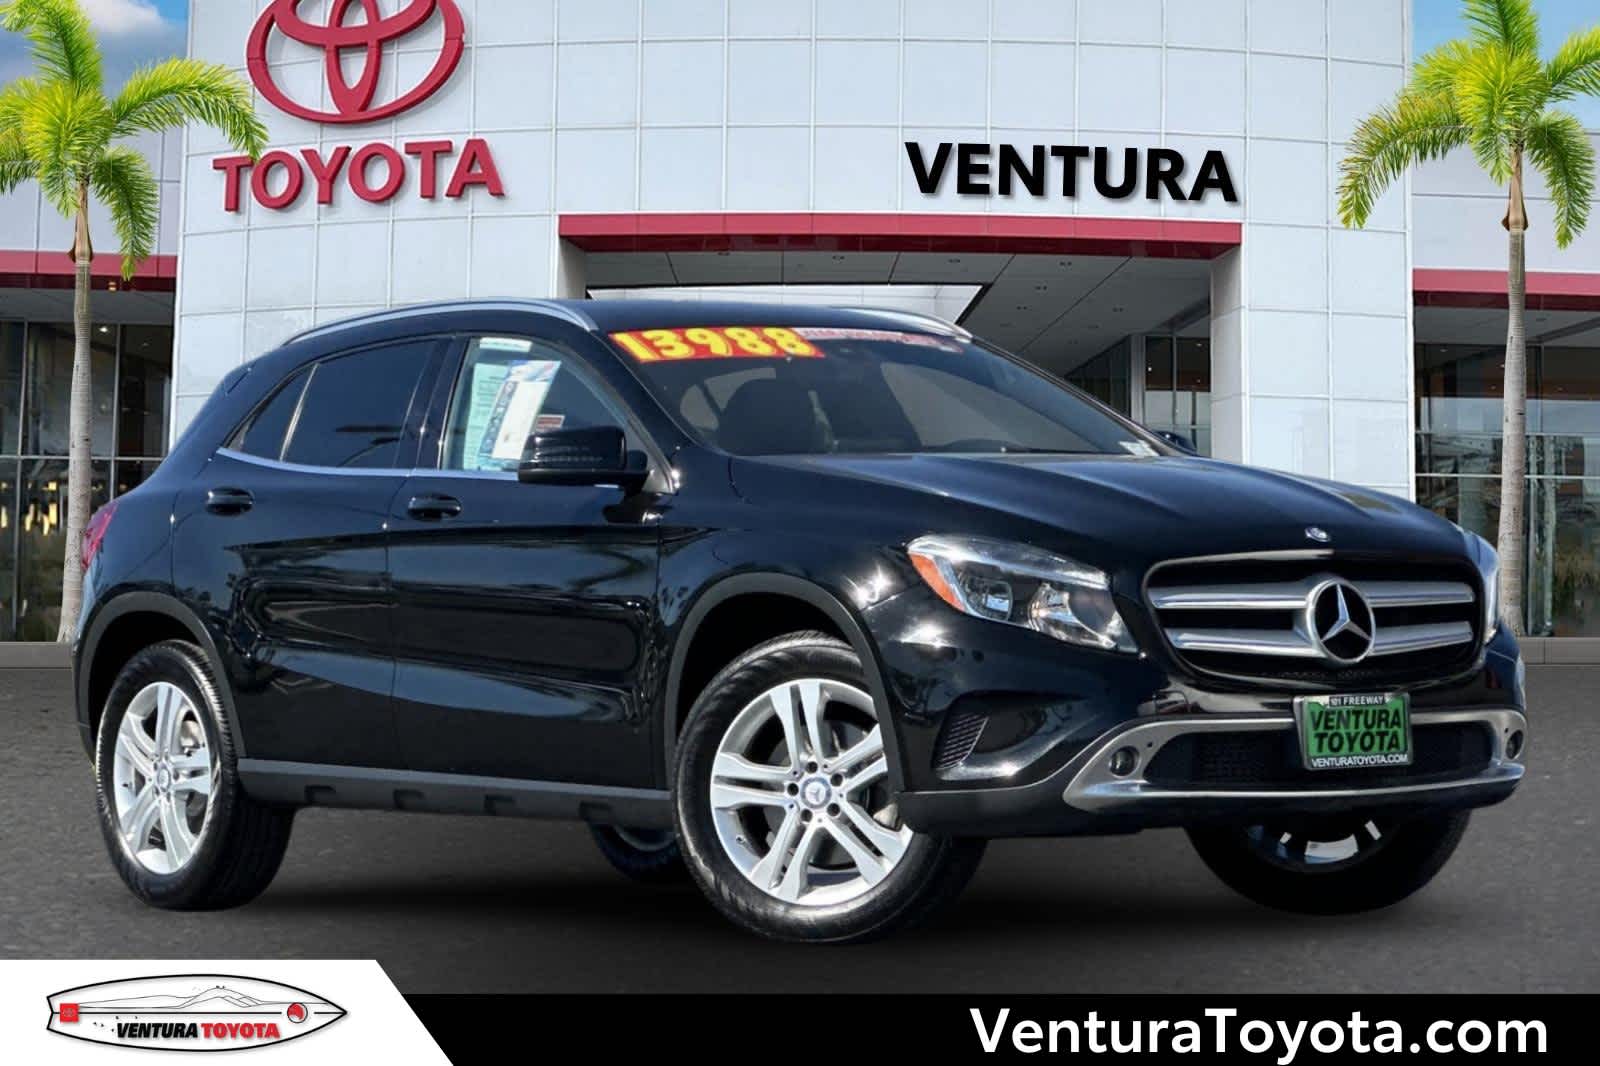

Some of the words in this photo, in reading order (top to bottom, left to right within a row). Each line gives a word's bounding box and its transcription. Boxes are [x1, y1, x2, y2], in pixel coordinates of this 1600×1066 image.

[212, 138, 505, 212] TOYOTA
[905, 142, 1239, 203] VENTURA
[612, 327, 815, 361] 13988
[1343, 696, 1384, 706] FREEWAY
[1310, 709, 1402, 730] VENTURA
[1314, 731, 1401, 753] TOYOTA
[1311, 754, 1408, 768] VENTURATOYOTA.COM
